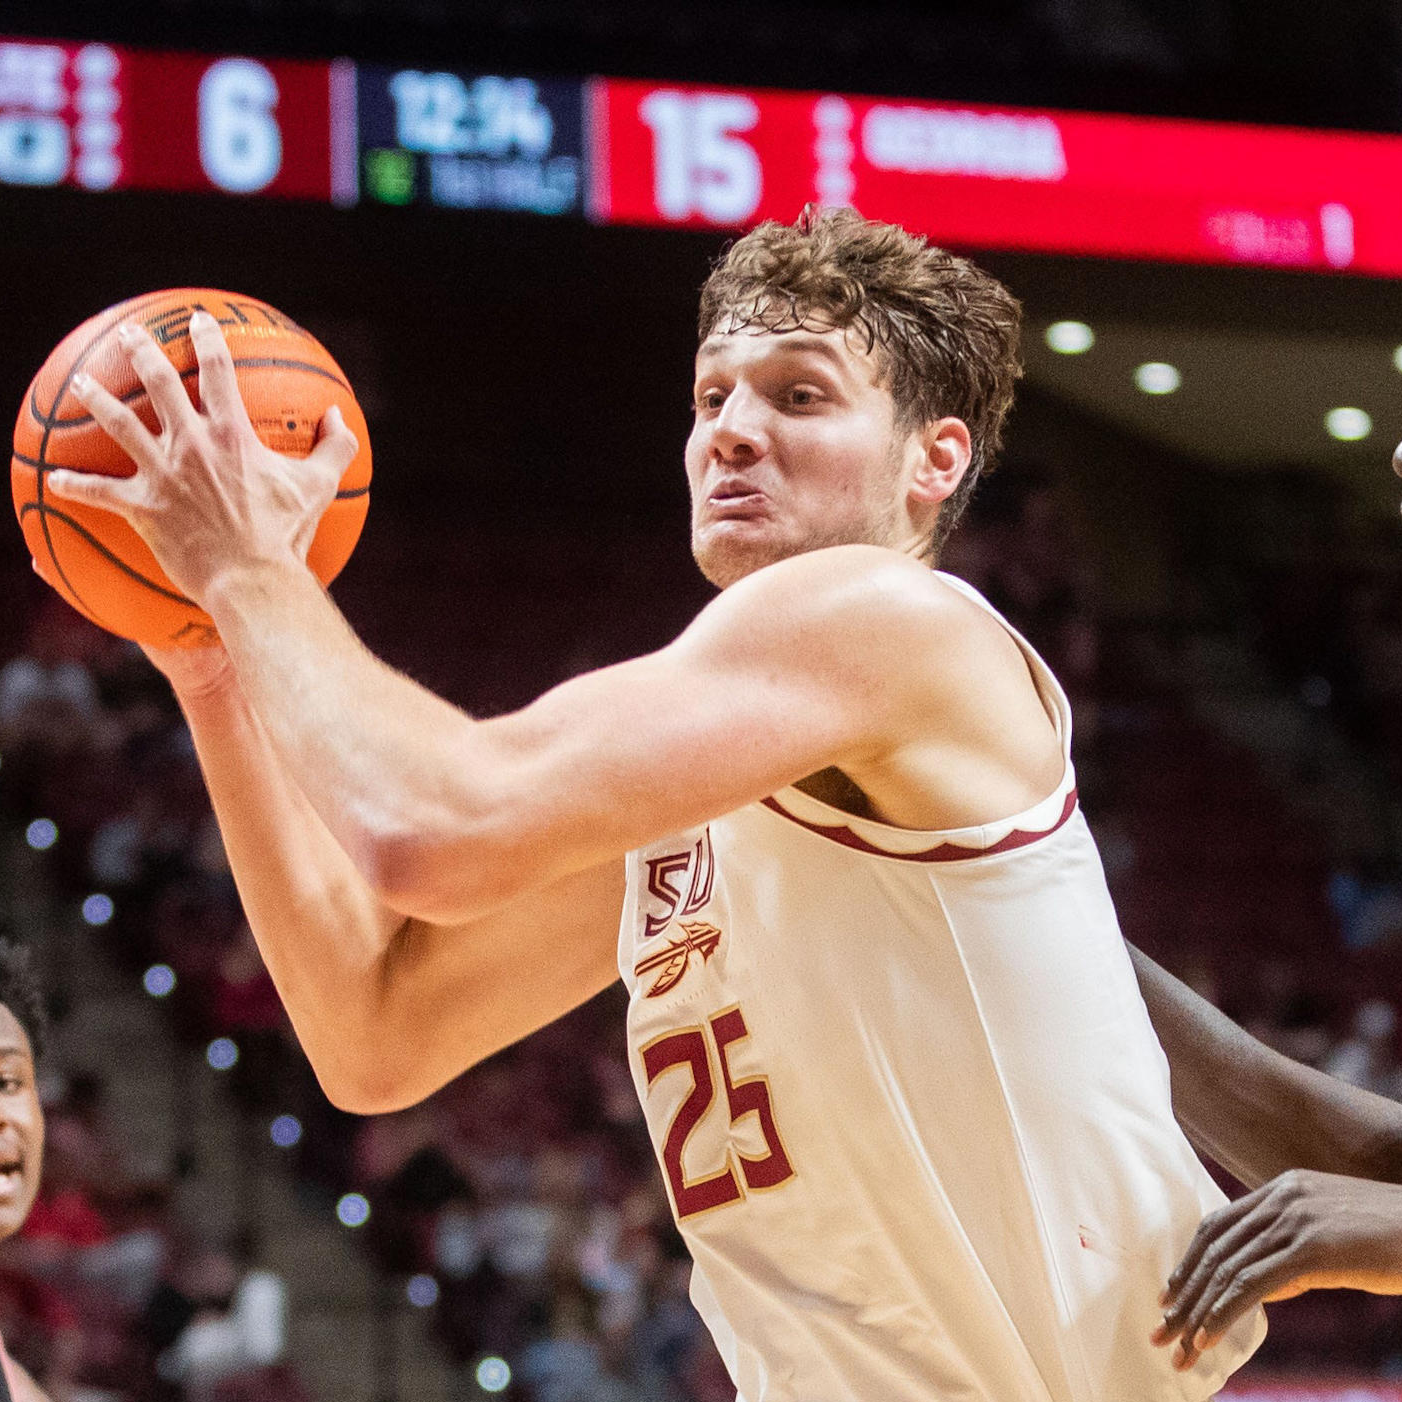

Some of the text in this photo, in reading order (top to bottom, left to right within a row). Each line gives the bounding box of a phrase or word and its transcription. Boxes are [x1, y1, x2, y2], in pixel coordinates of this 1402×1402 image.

[196, 57, 282, 194] 6
[638, 89, 763, 224] 15
[639, 1002, 798, 1223] 25
